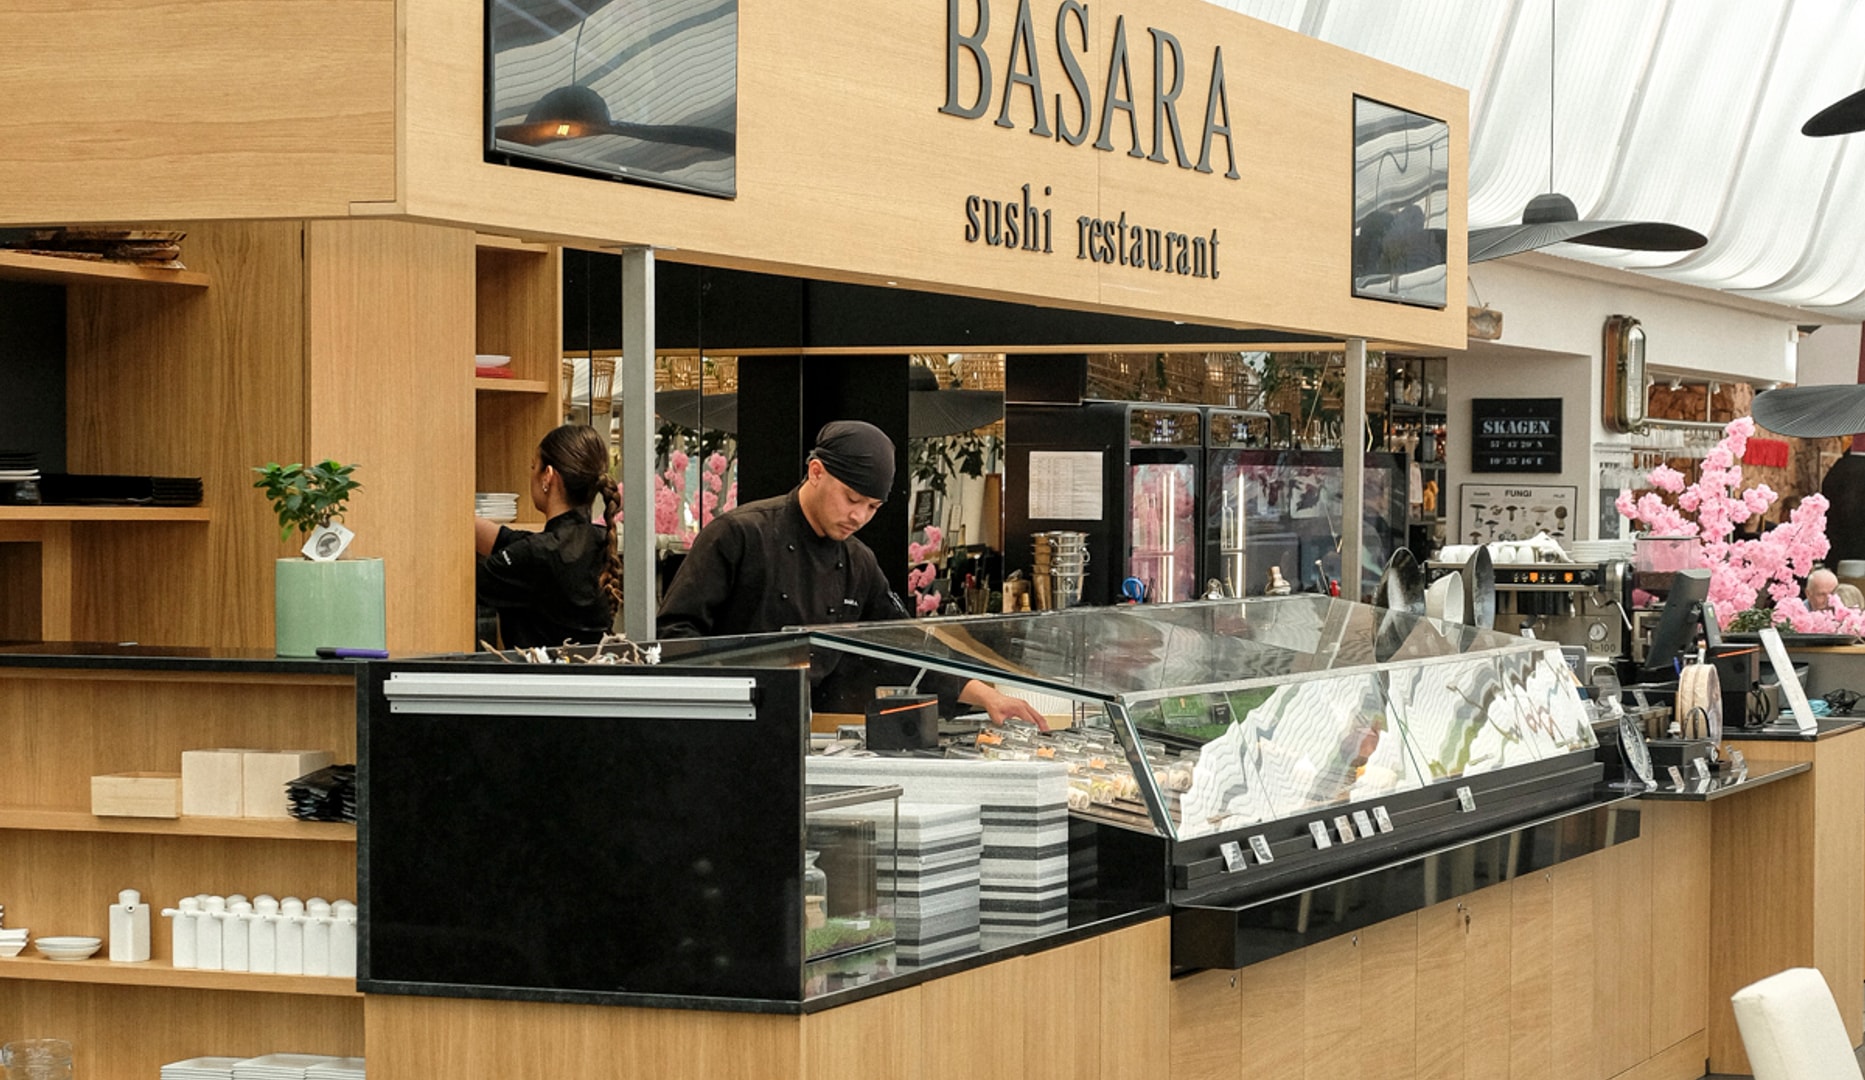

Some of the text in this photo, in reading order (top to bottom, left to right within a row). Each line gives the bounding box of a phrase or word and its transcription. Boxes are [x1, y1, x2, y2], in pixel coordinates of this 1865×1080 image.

[938, 0, 1241, 181] BASARA
[965, 183, 1220, 279] sushi restaurant
[1483, 420, 1550, 434] SKAGEN
[1505, 489, 1532, 497] FUNGI
